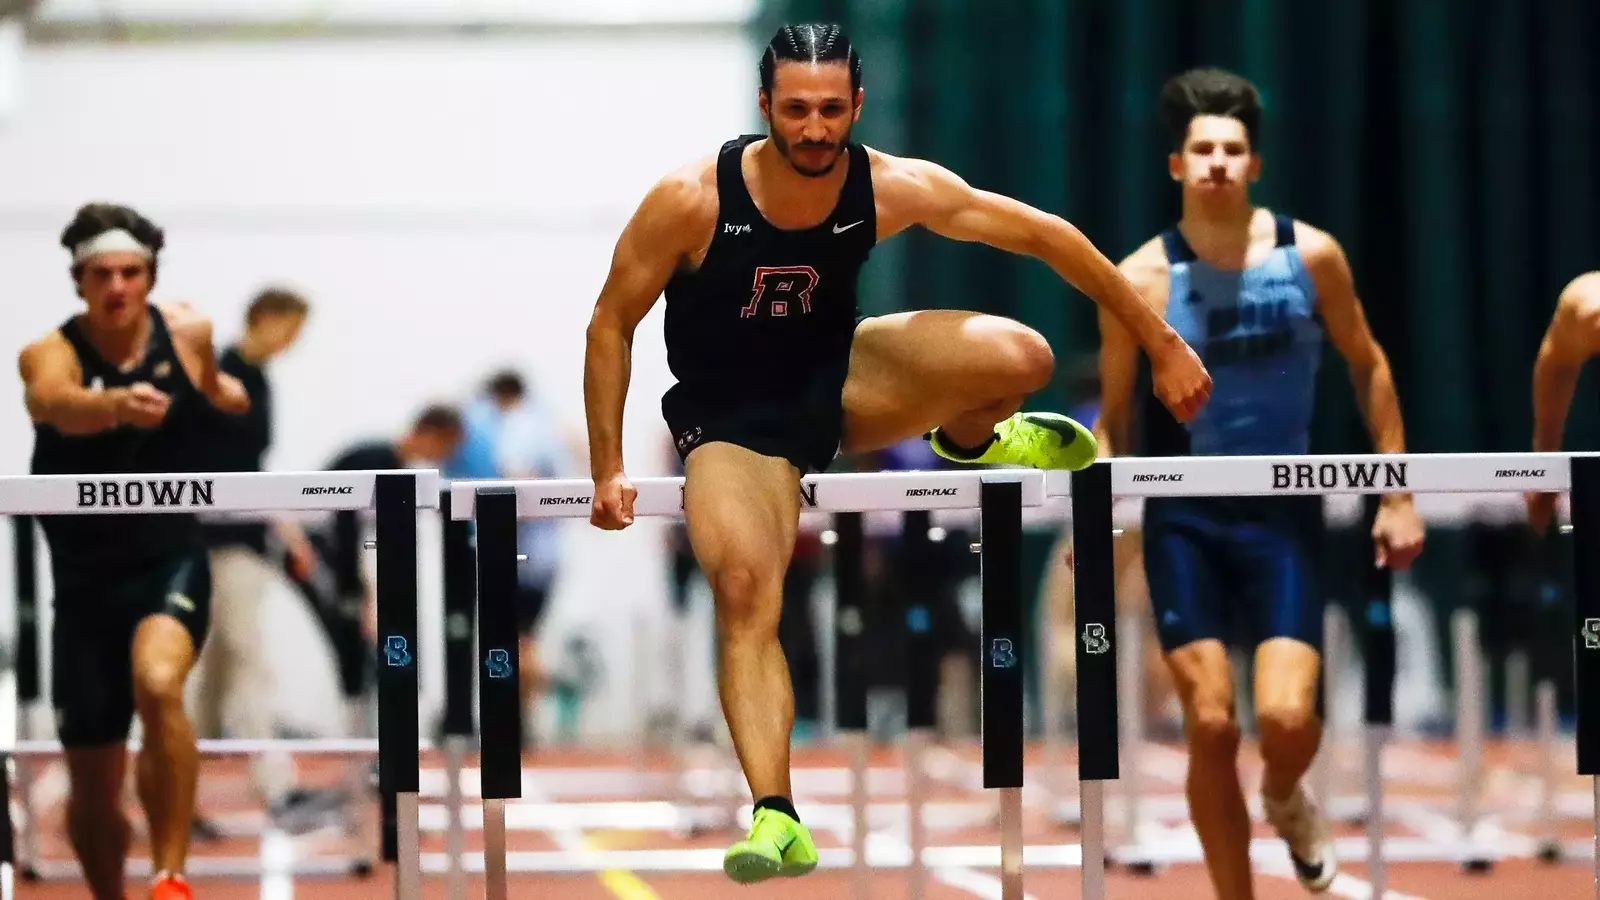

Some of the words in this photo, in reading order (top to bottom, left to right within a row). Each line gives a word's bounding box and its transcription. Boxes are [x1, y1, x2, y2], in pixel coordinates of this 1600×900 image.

[723, 222, 743, 235] Ivy
[1132, 474, 1155, 482] FIRST
[1158, 473, 1184, 481] PLACE
[1271, 461, 1408, 490] BROWN
[1495, 470, 1517, 478] FIRST
[1520, 469, 1546, 477] PLACE
[76, 479, 215, 508] BROWN
[302, 487, 325, 495] FIRST
[327, 486, 354, 494] PLACE
[906, 488, 929, 497] FIRST
[932, 487, 958, 496] PLACE
[540, 497, 561, 505] FIRST
